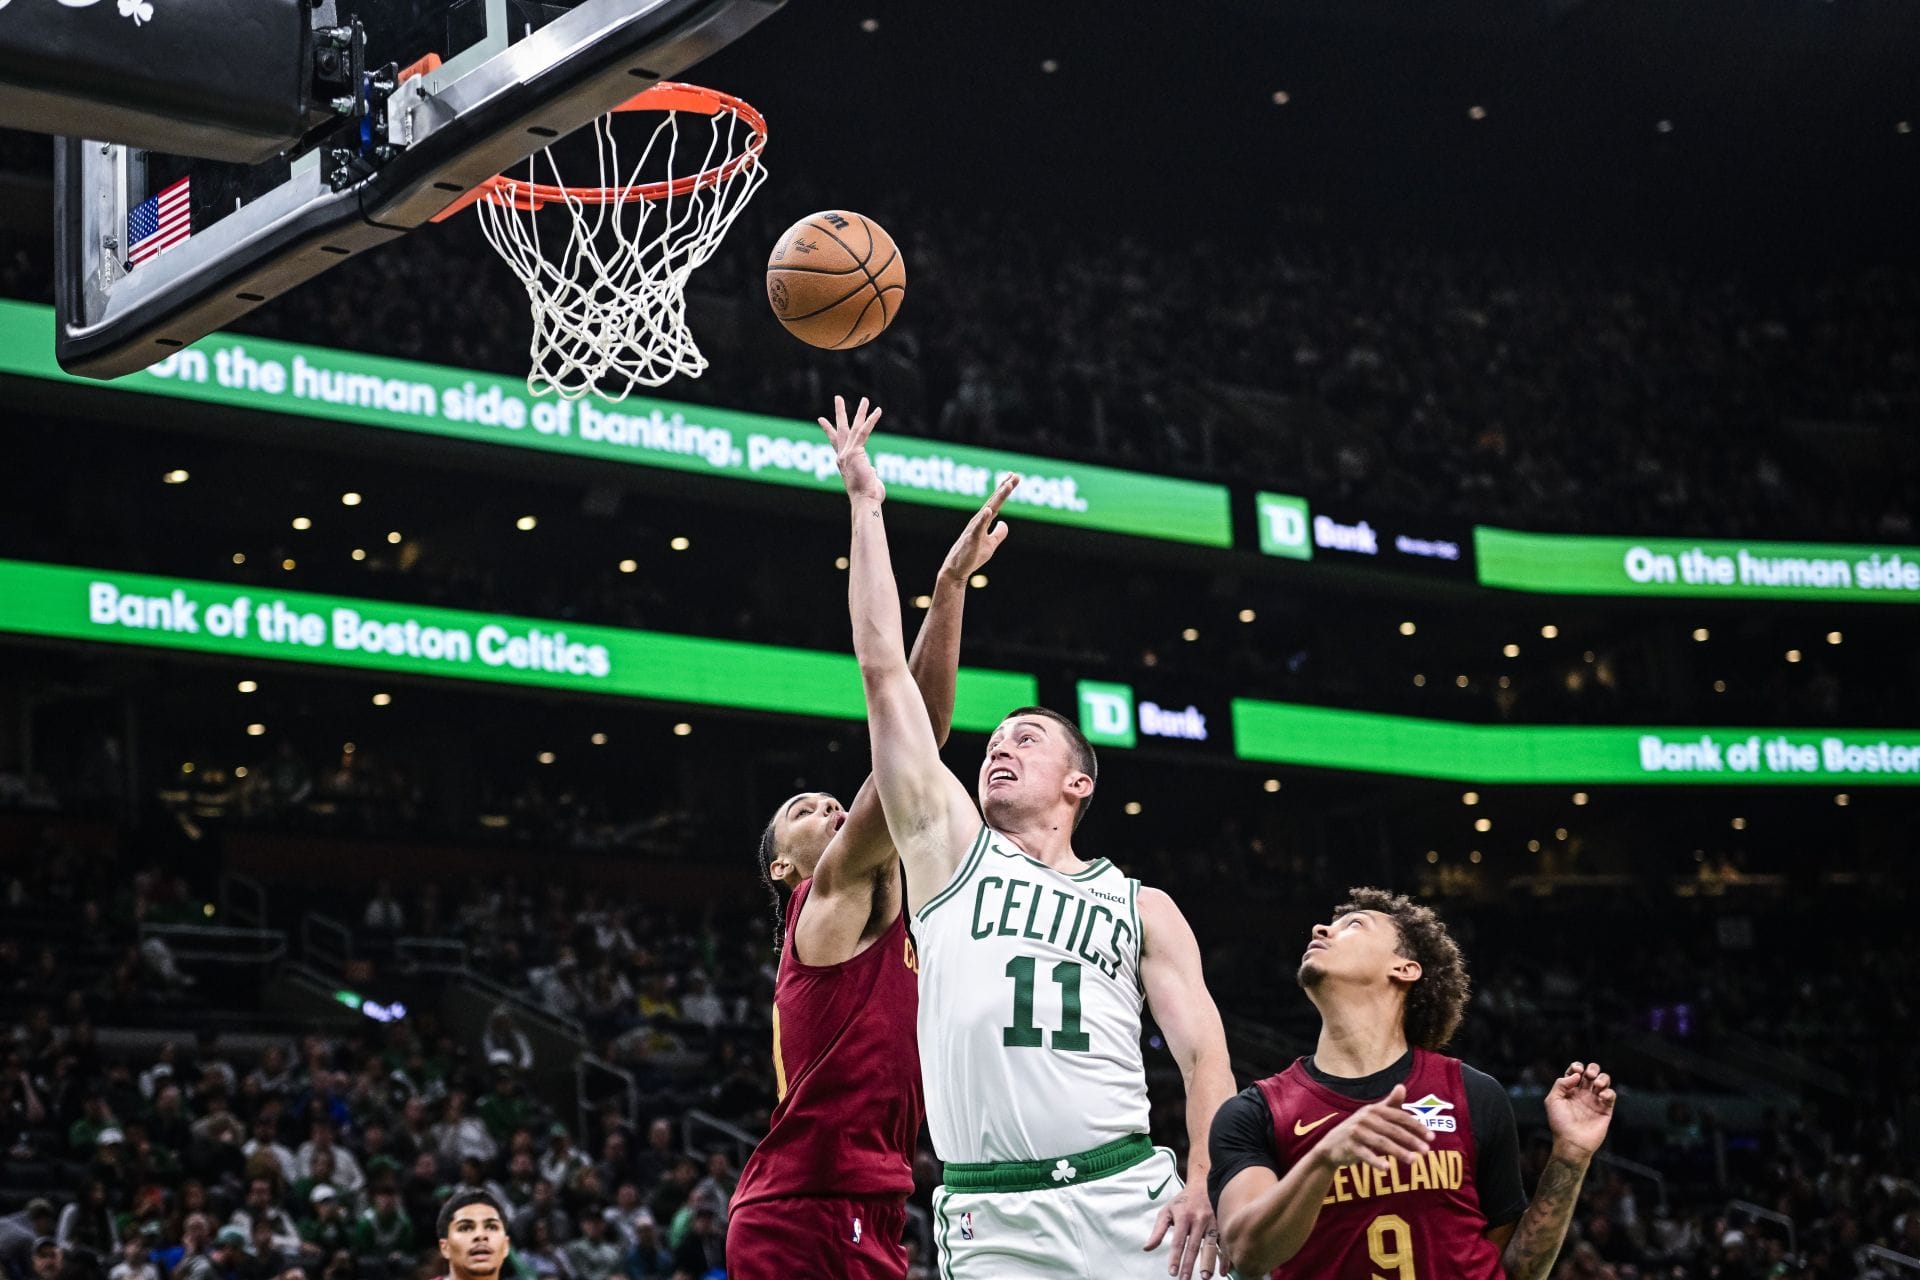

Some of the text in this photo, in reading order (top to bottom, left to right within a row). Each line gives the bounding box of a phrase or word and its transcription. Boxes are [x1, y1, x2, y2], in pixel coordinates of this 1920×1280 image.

[214, 346, 287, 394] the
[292, 354, 437, 417] human
[442, 381, 527, 430] side
[531, 397, 573, 437] of
[747, 433, 872, 481] peop
[875, 452, 992, 497] matter
[1263, 502, 1308, 547] TD
[1313, 514, 1379, 555] Bank
[1624, 546, 1920, 590] On the human side
[89, 581, 611, 677] Bank of the Boston Celtics
[1086, 691, 1208, 741] TD Bank
[1638, 735, 1723, 772] Bank
[1726, 735, 1762, 772] of
[1764, 736, 1819, 773] the
[970, 875, 1133, 981] CELTICS
[1003, 955, 1090, 1053] 11
[1417, 1118, 1455, 1129] IFFS
[1321, 1149, 1464, 1206] EVELAND
[1366, 1213, 1417, 1280] 9
